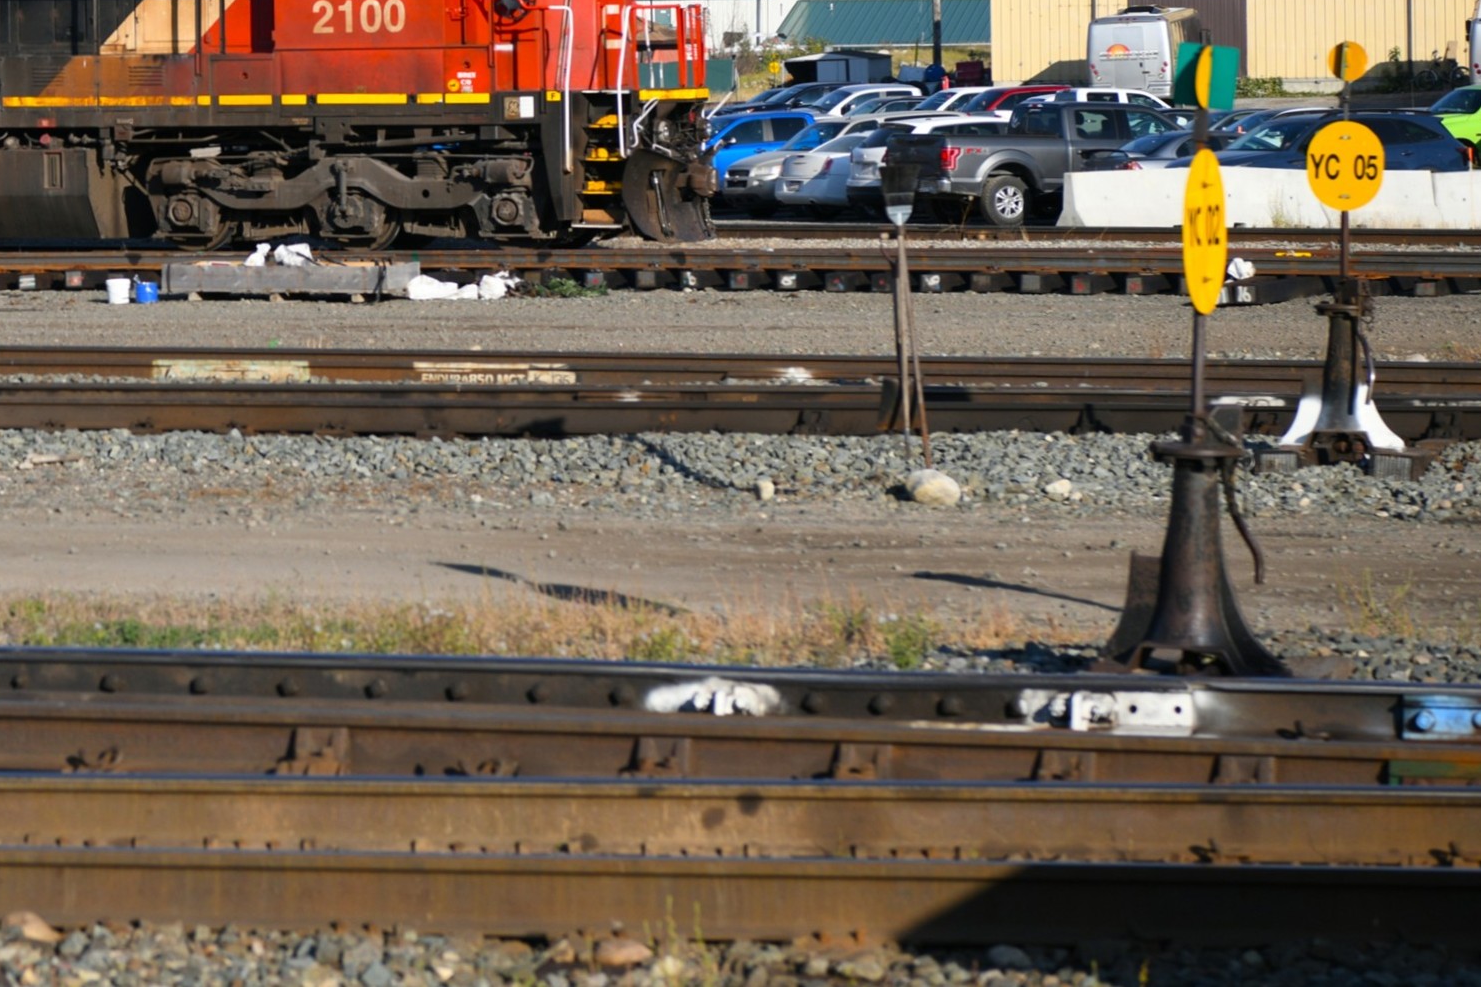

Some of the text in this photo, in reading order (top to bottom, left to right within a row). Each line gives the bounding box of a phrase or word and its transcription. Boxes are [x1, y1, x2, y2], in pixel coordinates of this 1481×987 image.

[1310, 154, 1378, 181] YC 05
[1236, 286, 1251, 302] 16
